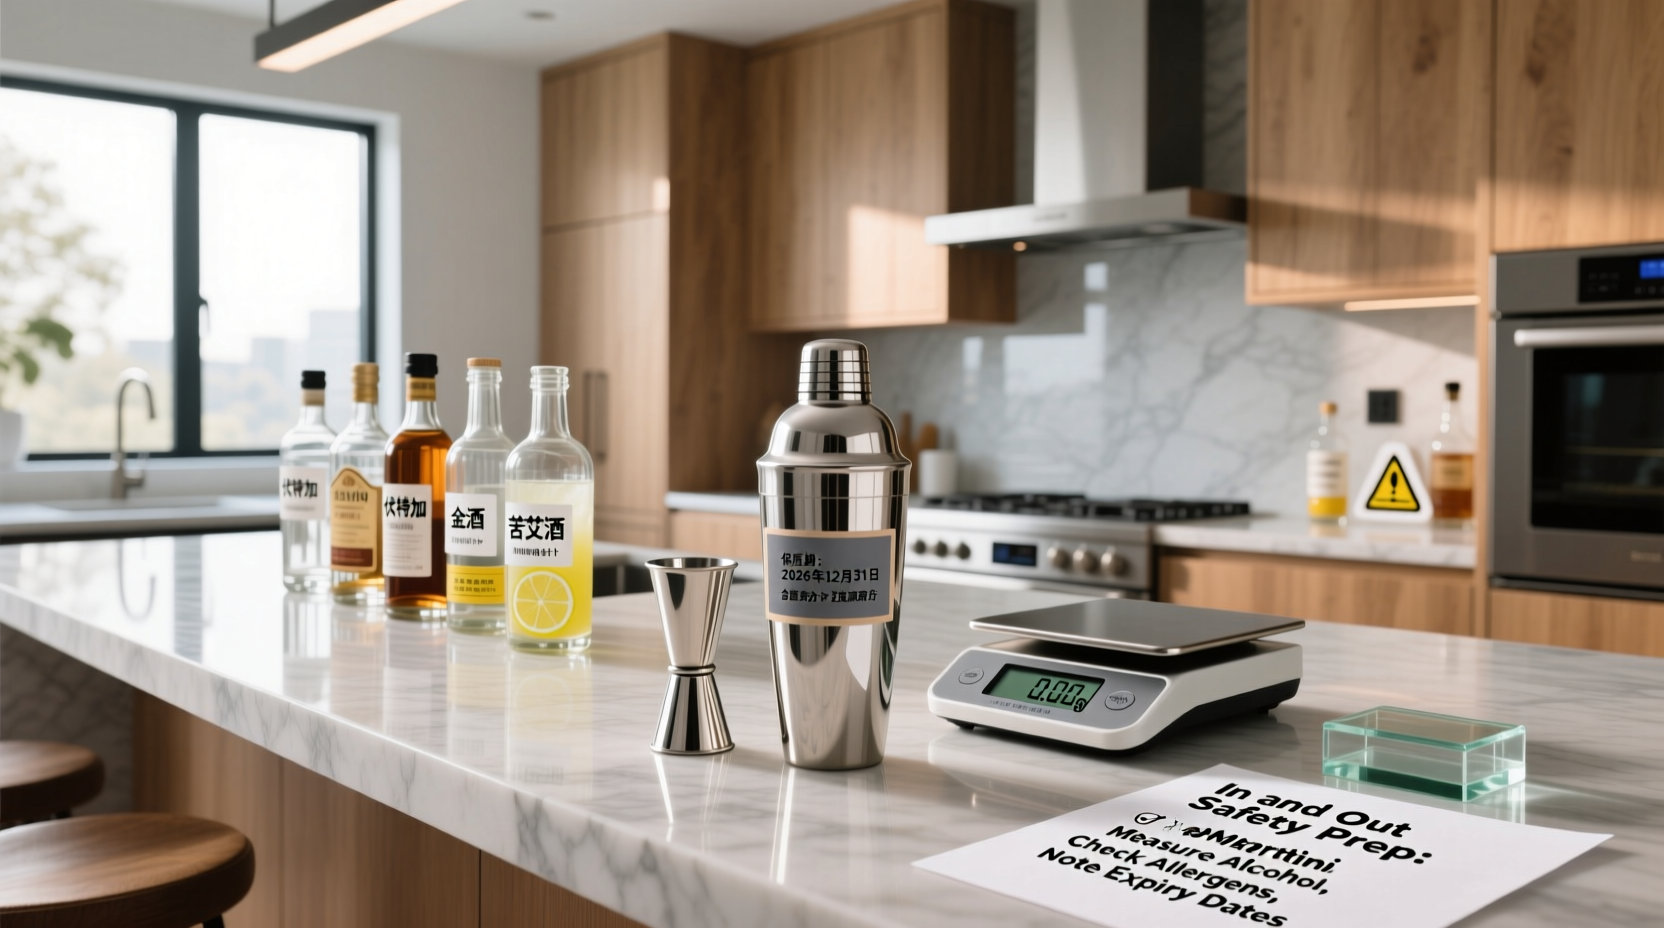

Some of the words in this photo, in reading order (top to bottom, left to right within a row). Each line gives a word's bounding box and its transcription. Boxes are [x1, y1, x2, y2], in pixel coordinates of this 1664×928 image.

[282, 478, 318, 498] 伏特加
[384, 496, 427, 518] 伏特加
[451, 506, 485, 530] 金酒
[508, 515, 565, 541] 苦艾酒
[781, 568, 879, 584] 2026年12月31日
[1188, 796, 1312, 835] Safety
[1315, 825, 1433, 865] Prep:
[1214, 782, 1252, 800] In
[1256, 794, 1334, 818] and
[1336, 811, 1412, 839] Out
[1068, 835, 1147, 864] Check
[1145, 857, 1279, 904] Allergens,
[1106, 826, 1215, 862] Measure
[1217, 856, 1331, 896] Alcohol,
[1037, 847, 1102, 874] Note
[1103, 865, 1197, 902] Expiry
[1197, 893, 1288, 928] Dates
